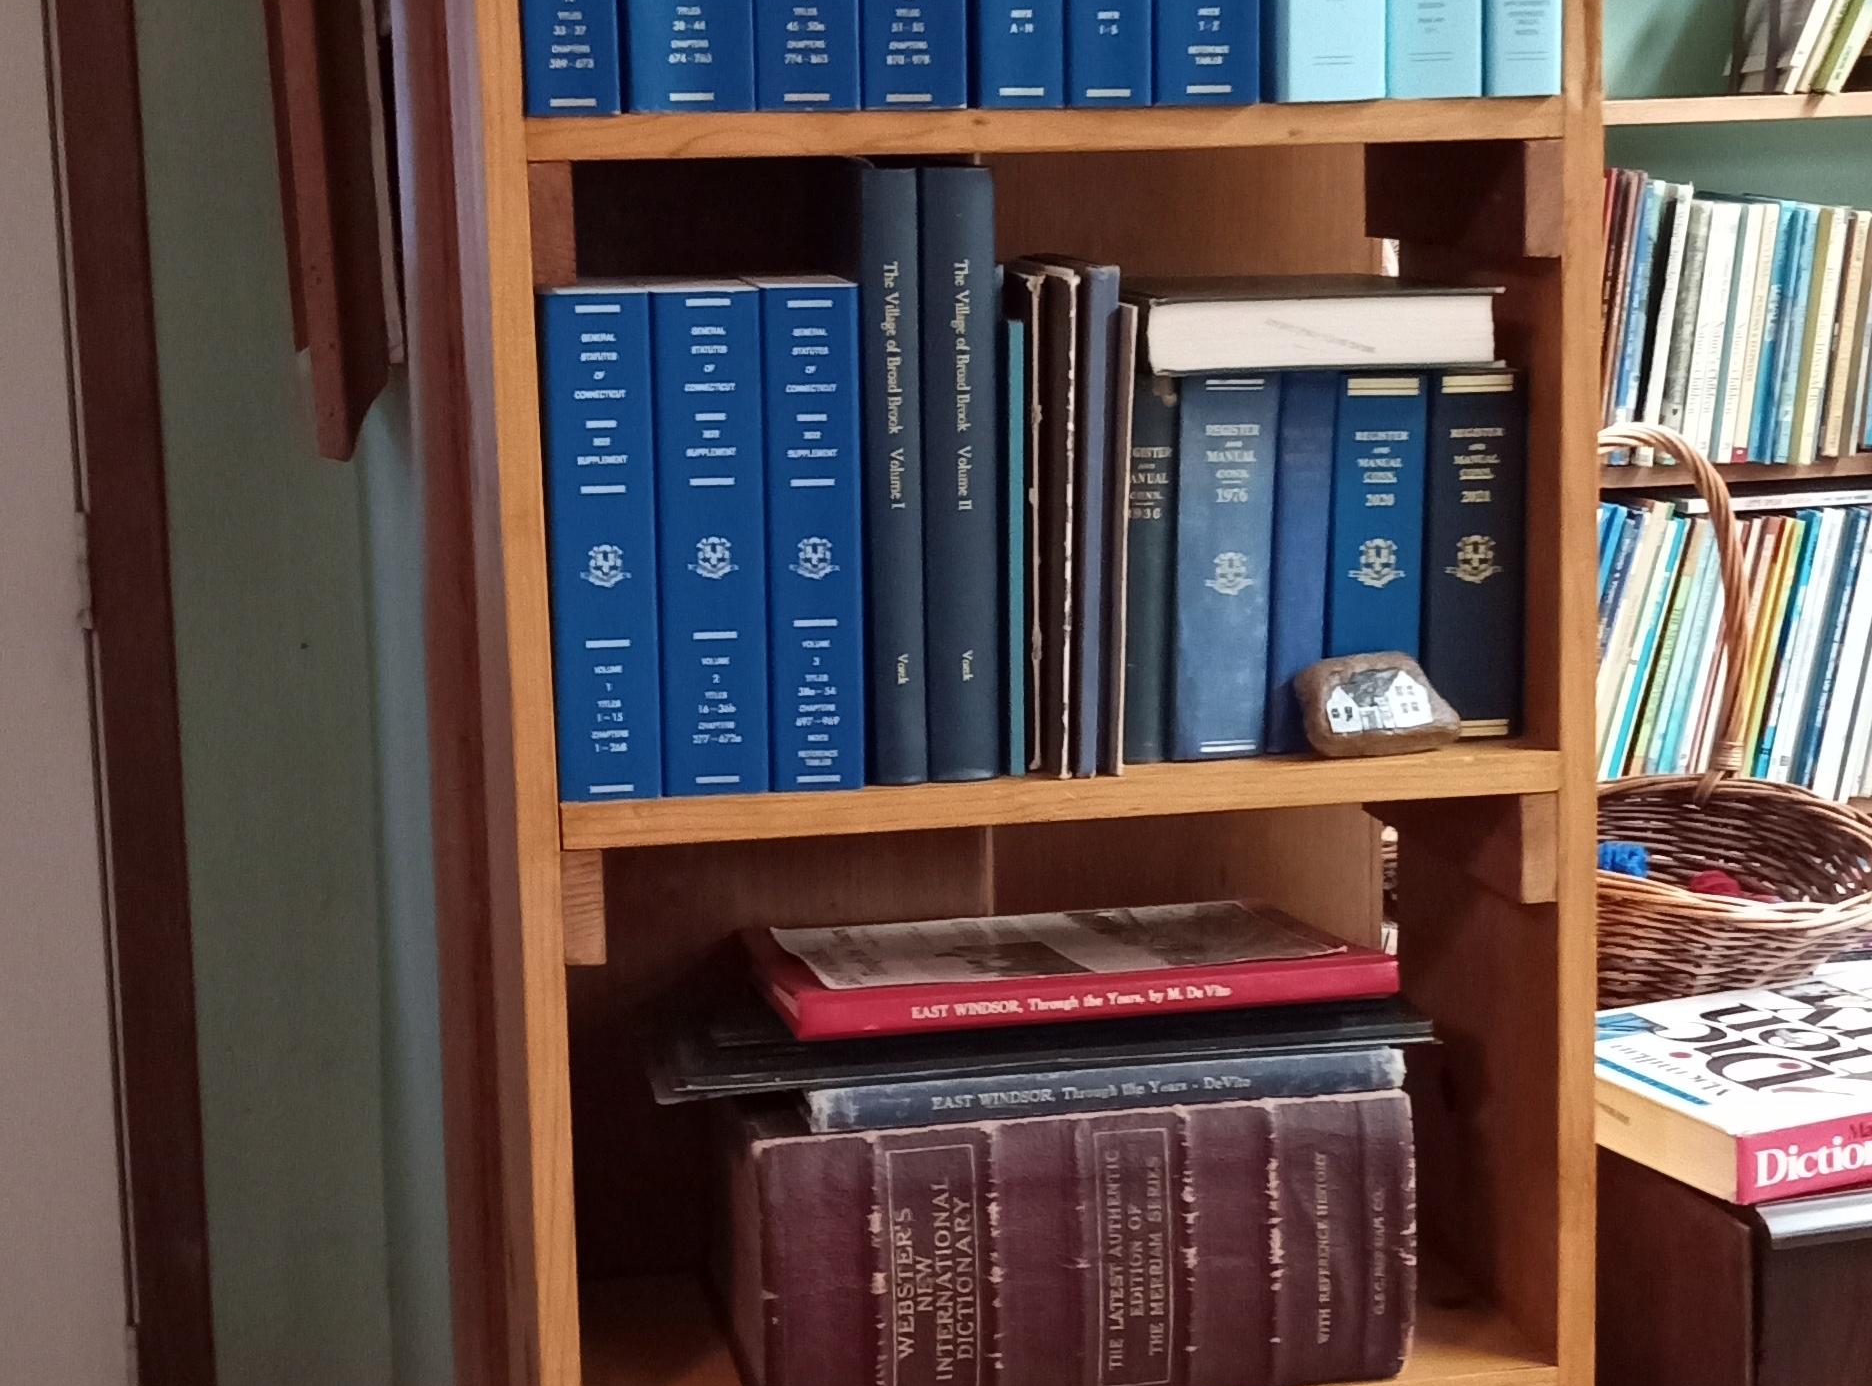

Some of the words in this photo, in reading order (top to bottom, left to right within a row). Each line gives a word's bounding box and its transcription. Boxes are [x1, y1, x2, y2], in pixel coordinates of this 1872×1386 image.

[883, 261, 899, 288] The
[953, 259, 970, 286] The
[881, 292, 900, 336] Village
[951, 290, 970, 334] Village
[580, 332, 617, 343] GENERAL
[690, 326, 727, 336] GENERAL
[791, 327, 828, 337] GENERAL
[886, 340, 901, 352] of
[956, 337, 971, 350] of
[592, 370, 606, 380] OF
[703, 363, 716, 373] OF
[804, 365, 817, 374] OF
[887, 356, 902, 392] Broad
[956, 354, 971, 390] Broad
[887, 396, 903, 433] Brook
[957, 394, 971, 431] Brook
[1205, 423, 1260, 436] REGISTER
[1355, 431, 1410, 441] REGISTER
[1450, 427, 1504, 438] REGISTER
[957, 445, 972, 496] Volume
[1206, 450, 1256, 462] MANUAL
[1357, 458, 1403, 467] MANUAL
[1453, 454, 1500, 464] MANUAL
[889, 448, 905, 499] Volume
[1129, 472, 1169, 484] ANUAL
[958, 500, 973, 510] II
[1215, 488, 1249, 502] 1976
[711, 673, 721, 684] 2
[912, 1004, 949, 1019] EAST
[953, 999, 1024, 1016] WINDSOR,
[1027, 995, 1080, 1011] Through
[1083, 994, 1104, 1007] the
[1148, 989, 1165, 1003] by
[931, 1094, 974, 1110] EAST
[1061, 1084, 1119, 1100] Through
[1121, 1082, 1146, 1096] the
[1148, 1080, 1188, 1093] Years
[1147, 1157, 1162, 1223] SERIES
[1315, 1152, 1328, 1215] HISTORY
[1105, 1150, 1123, 1258] AUTHENTIC
[1127, 1204, 1142, 1230] OF
[1149, 1232, 1165, 1316] MERRIAM
[1316, 1221, 1331, 1302] REFERENCE
[894, 1207, 916, 1359] WEBSTER'S
[915, 1255, 934, 1311] NEW
[930, 1178, 954, 1380] INTERNATIONAL
[953, 1196, 974, 1360] DICTIONARY
[1128, 1241, 1145, 1317] EDITION
[1108, 1266, 1124, 1330] LATEST
[1149, 1322, 1164, 1355] THE
[1317, 1308, 1331, 1344] WITH
[1109, 1339, 1124, 1370] THE
